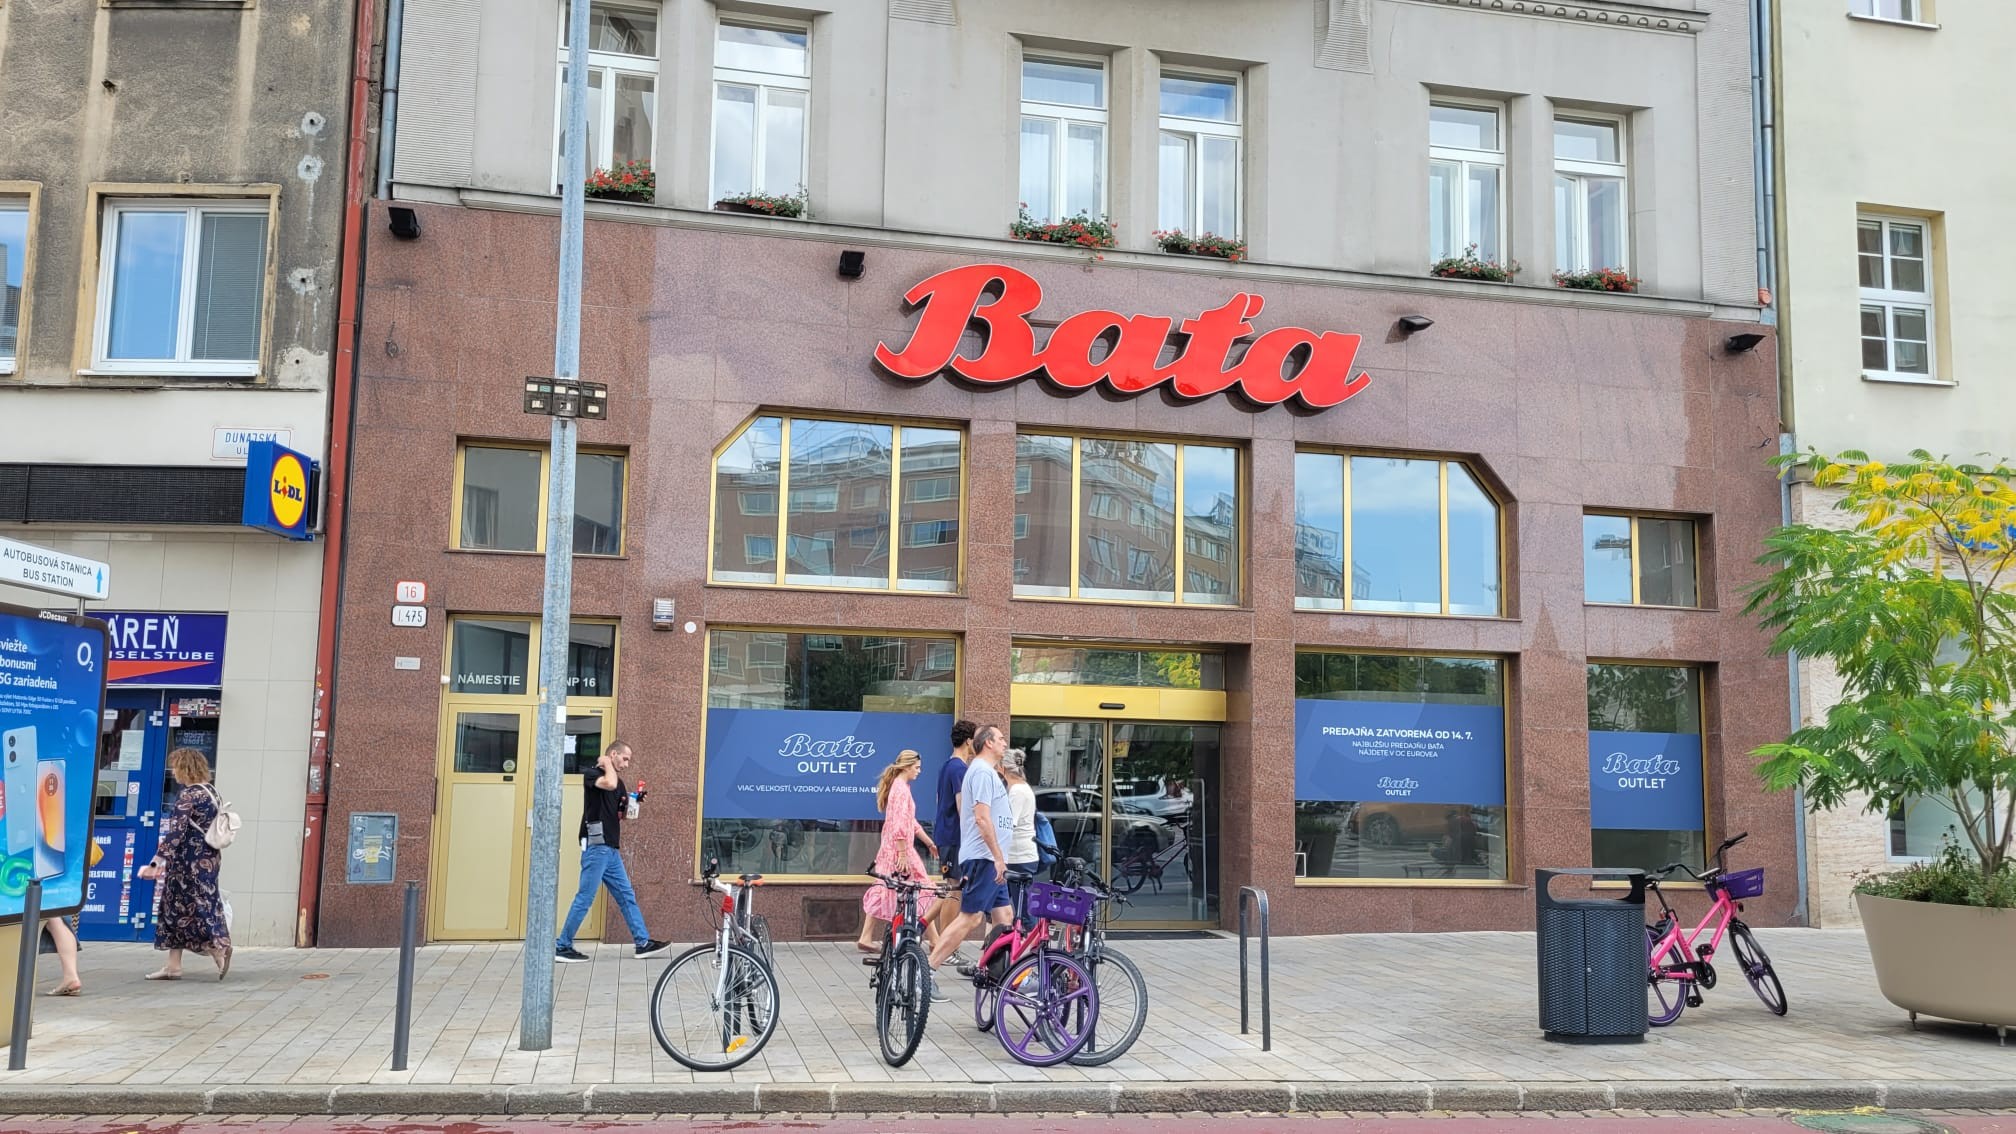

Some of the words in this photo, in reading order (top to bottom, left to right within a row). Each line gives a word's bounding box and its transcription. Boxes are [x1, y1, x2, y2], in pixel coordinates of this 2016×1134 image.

[874, 263, 1373, 408] Baťa
[3, 547, 59, 569] AUTOBUSOVÁ
[60, 560, 93, 577] STANICA
[23, 568, 40, 581] BUS
[41, 572, 74, 588] STATION
[404, 585, 417, 599] 16
[38, 610, 69, 623] JCDecaux
[107, 614, 180, 650] ÁREŇ
[0, 638, 28, 653] viežte
[13, 675, 58, 690] zariadenia
[457, 672, 521, 686] NÁMESTIE
[566, 676, 580, 688] NP
[582, 677, 597, 688] 16
[1322, 726, 1374, 738] PREDAJŇA
[1376, 728, 1433, 739] ZATVORENÁ
[1435, 730, 1450, 739] OD
[1451, 731, 1464, 740] 14.
[1465, 731, 1473, 740] 7.
[778, 733, 876, 759] Baťa
[1352, 740, 1389, 749] NAJBLIŽŠIU
[1391, 741, 1426, 750] PREDAJŇU
[1359, 748, 1388, 757] NÁJDETE
[1395, 750, 1406, 758] OC
[1407, 750, 1438, 758] EUROVEA
[797, 761, 857, 774] OUTLET
[1602, 752, 1681, 775] Baťa
[737, 784, 755, 793] VIAC
[793, 785, 824, 793] VZOROV
[825, 785, 831, 793] A
[1618, 777, 1667, 789] OUTLET
[1385, 789, 1412, 797] OUTLET
